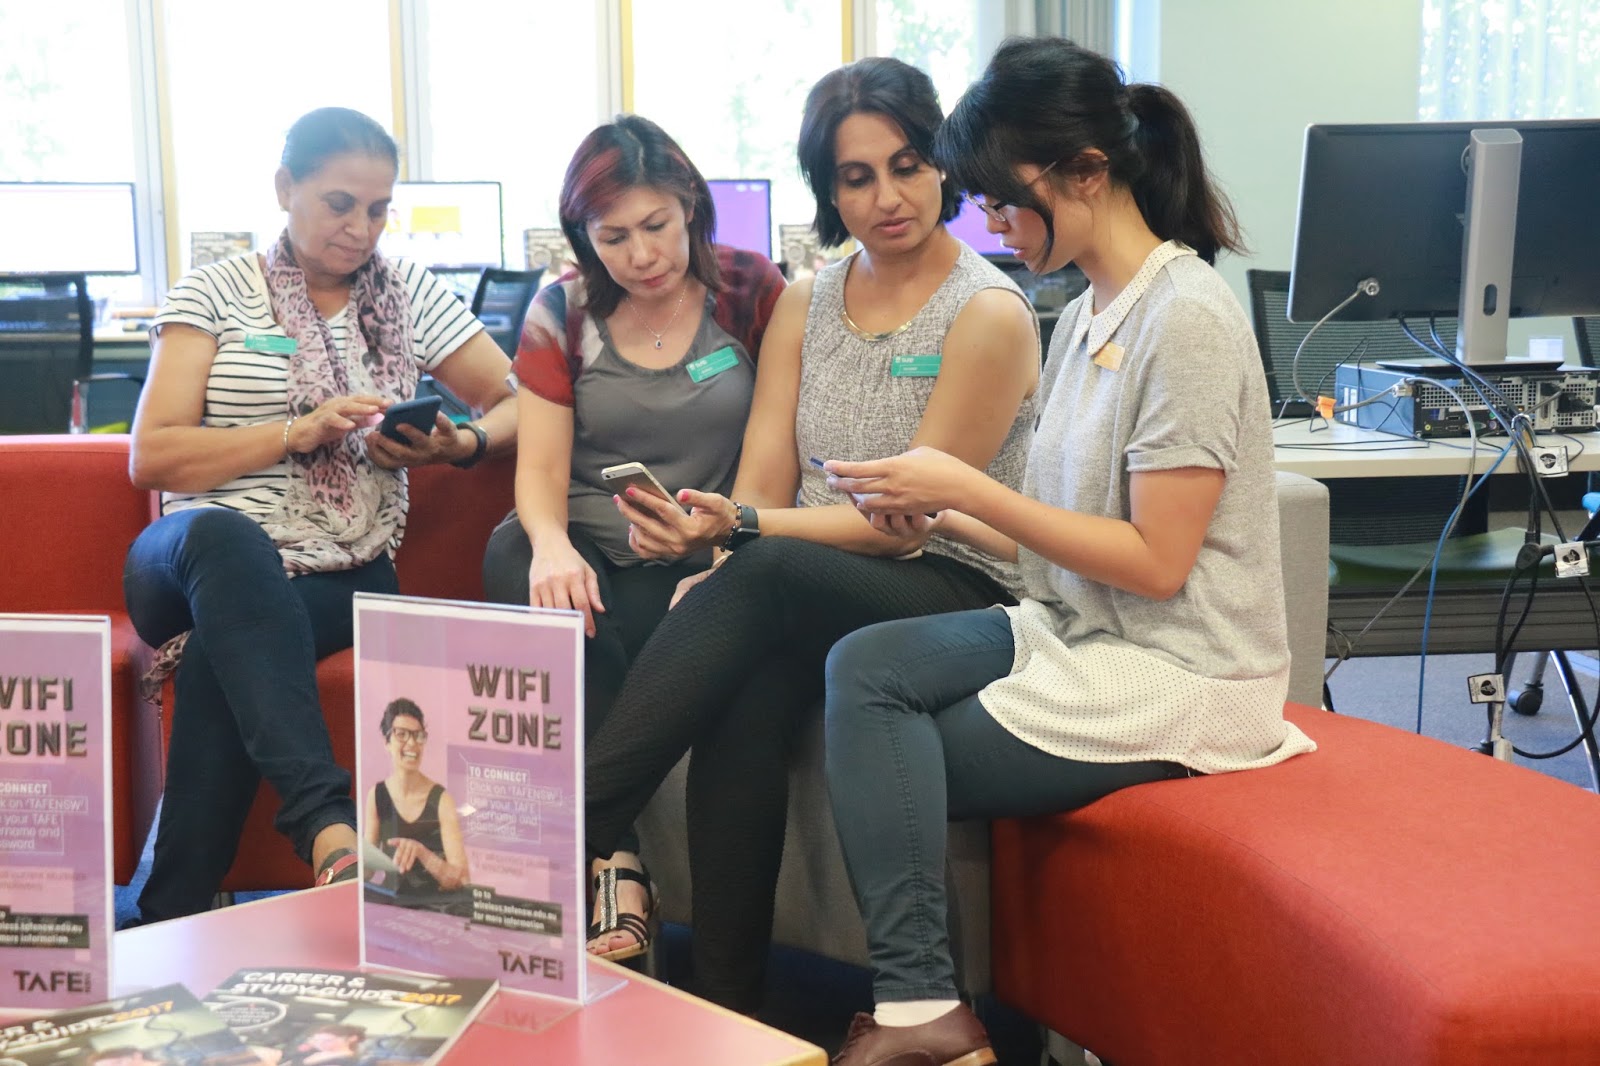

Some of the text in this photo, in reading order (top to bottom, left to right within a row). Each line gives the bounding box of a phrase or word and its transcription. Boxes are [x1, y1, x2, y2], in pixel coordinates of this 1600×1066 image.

[467, 663, 550, 704] WIFI
[467, 706, 562, 749] ZONE
[0, 720, 87, 757] ONE
[469, 766, 527, 783] TO CONNECT
[5, 813, 58, 826] your TAFE
[38, 826, 61, 838] and
[473, 888, 492, 900] Go to
[485, 914, 503, 924] more
[504, 917, 545, 931] information
[20, 933, 69, 945] information
[498, 948, 558, 980] TAFE
[13, 969, 85, 993] TAFE
[242, 971, 346, 988] CAREER
[400, 991, 462, 1006] 2017
